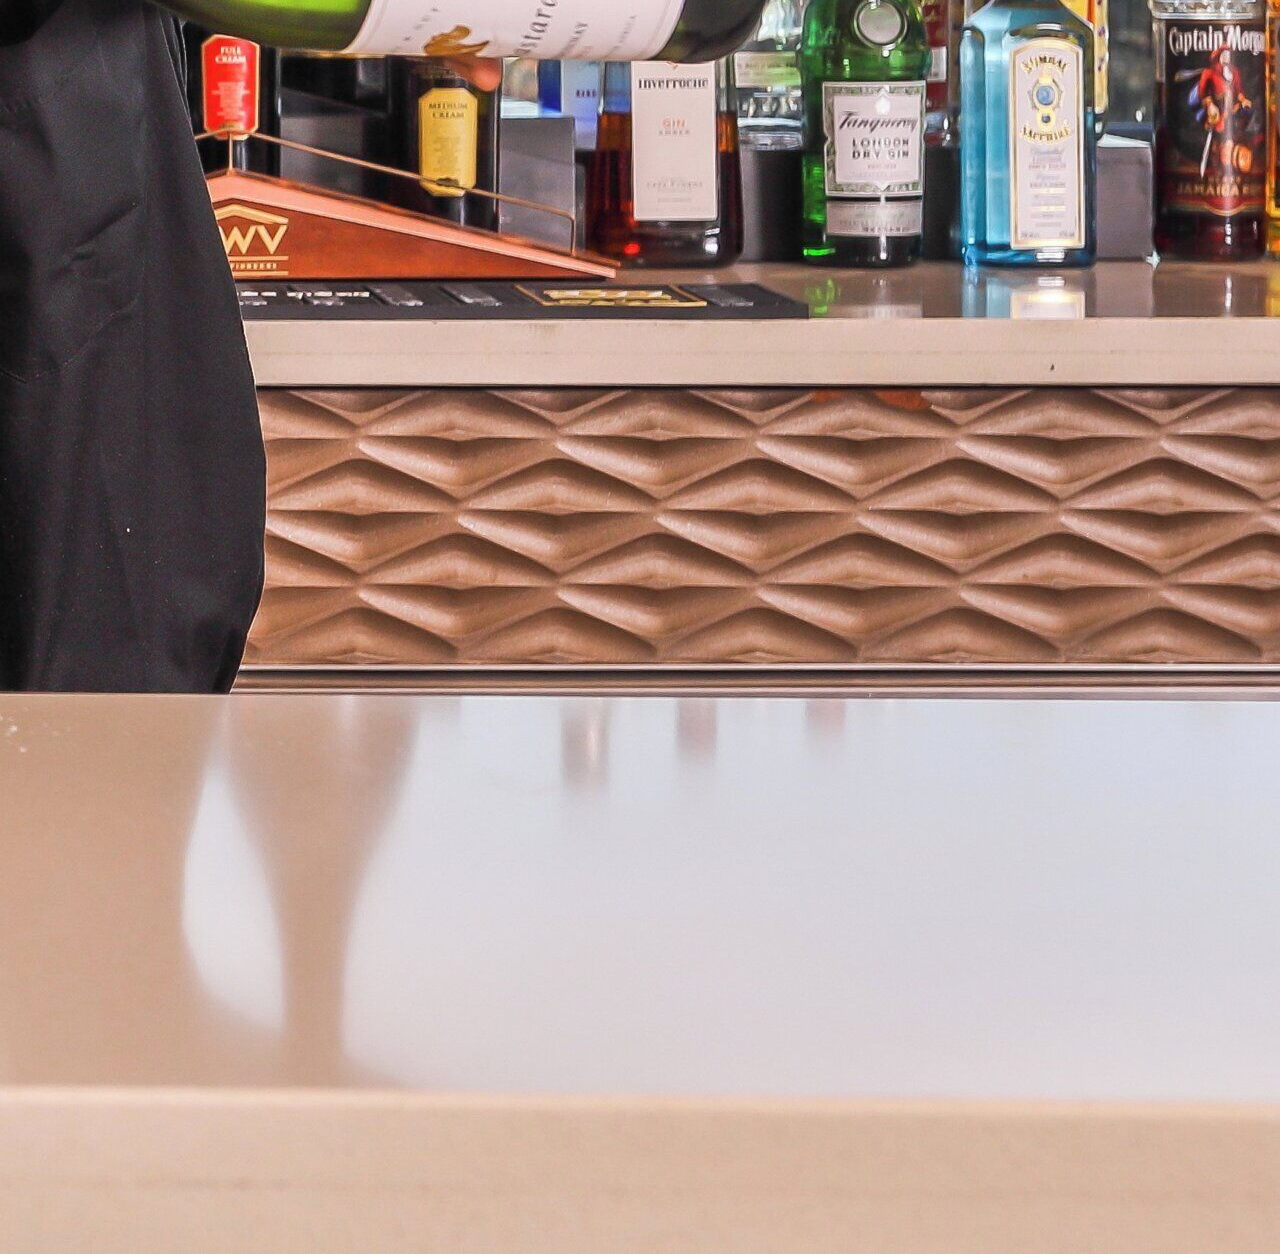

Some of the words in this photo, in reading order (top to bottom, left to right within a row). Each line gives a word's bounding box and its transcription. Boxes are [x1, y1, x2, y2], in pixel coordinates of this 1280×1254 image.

[1169, 24, 1225, 57] Captain
[1223, 23, 1266, 56] Morga
[428, 102, 468, 111] MEDIUM
[432, 111, 466, 120] CREAM
[851, 136, 910, 147] LONDON
[851, 149, 881, 160] DRY
[887, 149, 910, 160] GIN
[218, 224, 289, 256] WV
